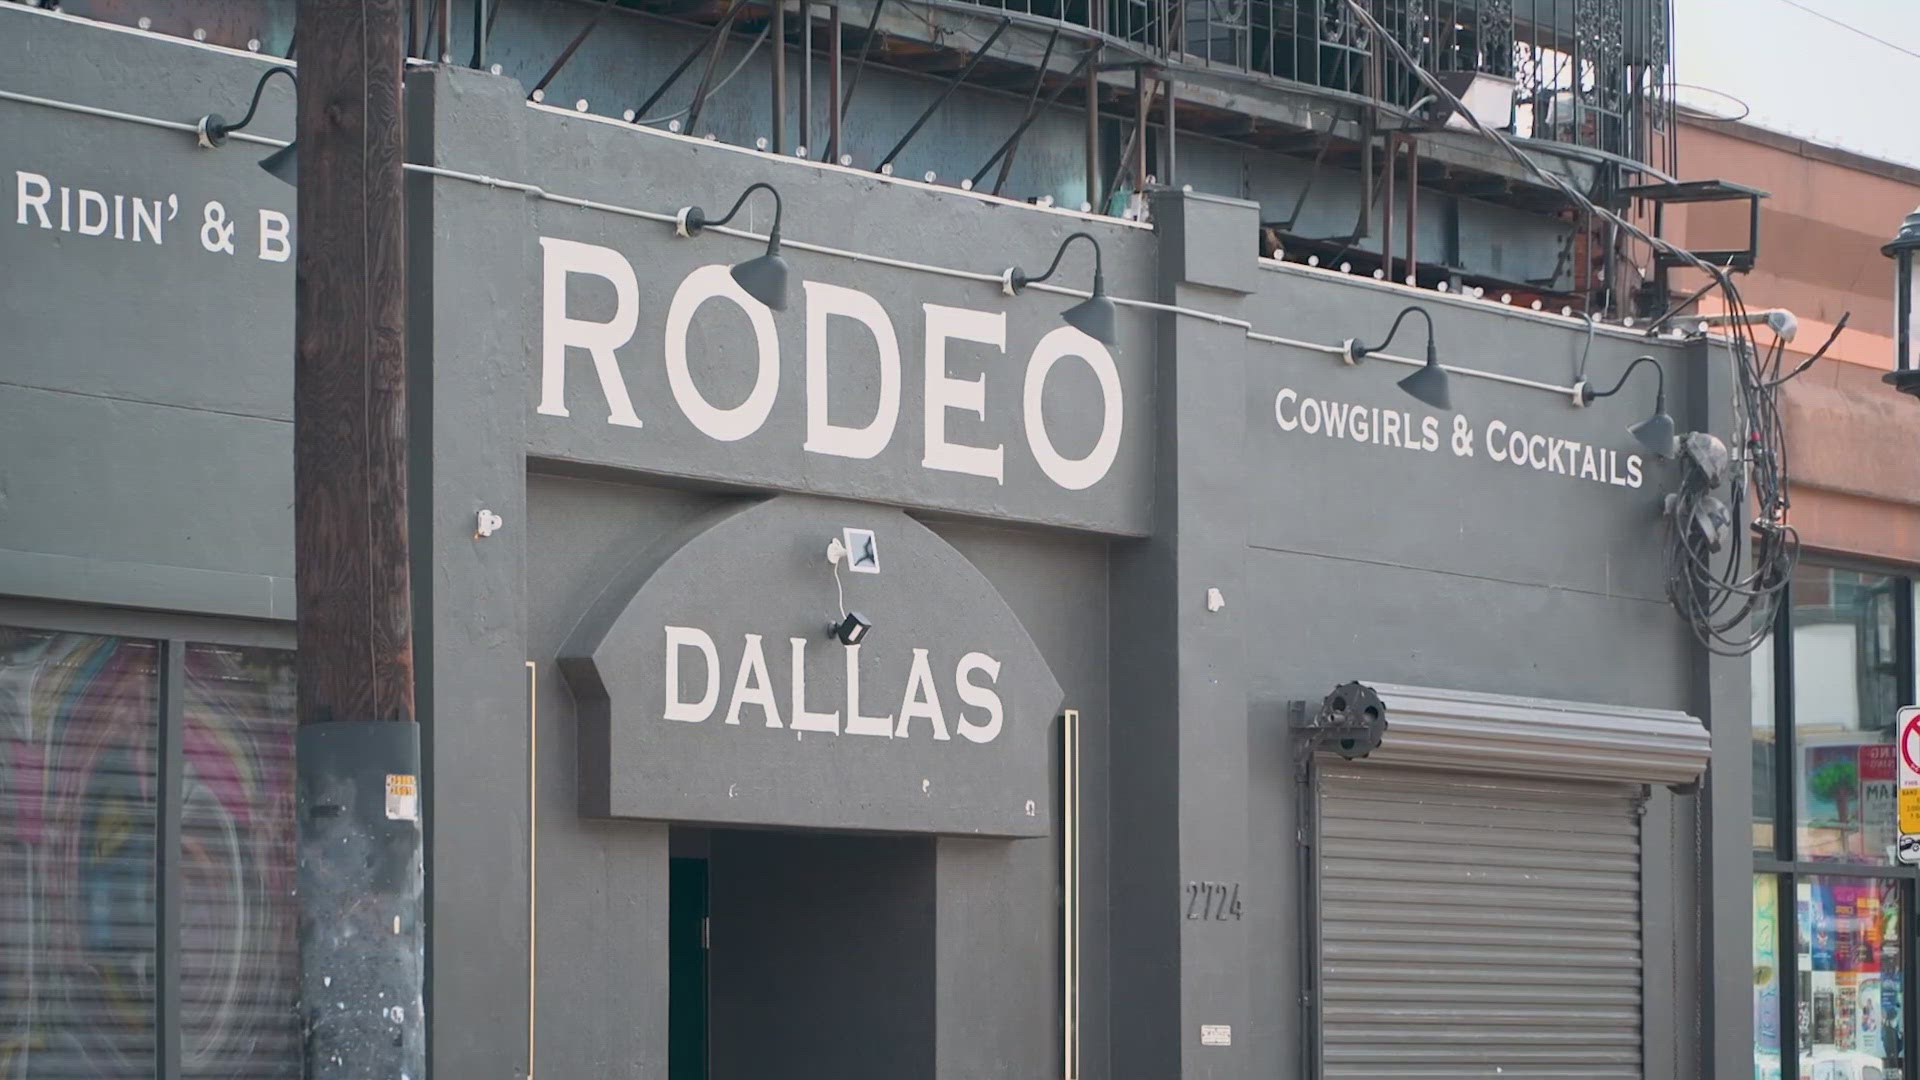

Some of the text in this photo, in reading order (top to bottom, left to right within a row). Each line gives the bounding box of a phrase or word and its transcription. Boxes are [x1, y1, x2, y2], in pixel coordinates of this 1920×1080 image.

[16, 171, 178, 245] RIDIN'
[200, 201, 234, 255] &
[537, 236, 1123, 490] RODEO
[1274, 387, 1643, 488] COWGIRLS & COCKTAILS
[663, 625, 1004, 744] DALLAS
[1186, 881, 1242, 921] 2724
